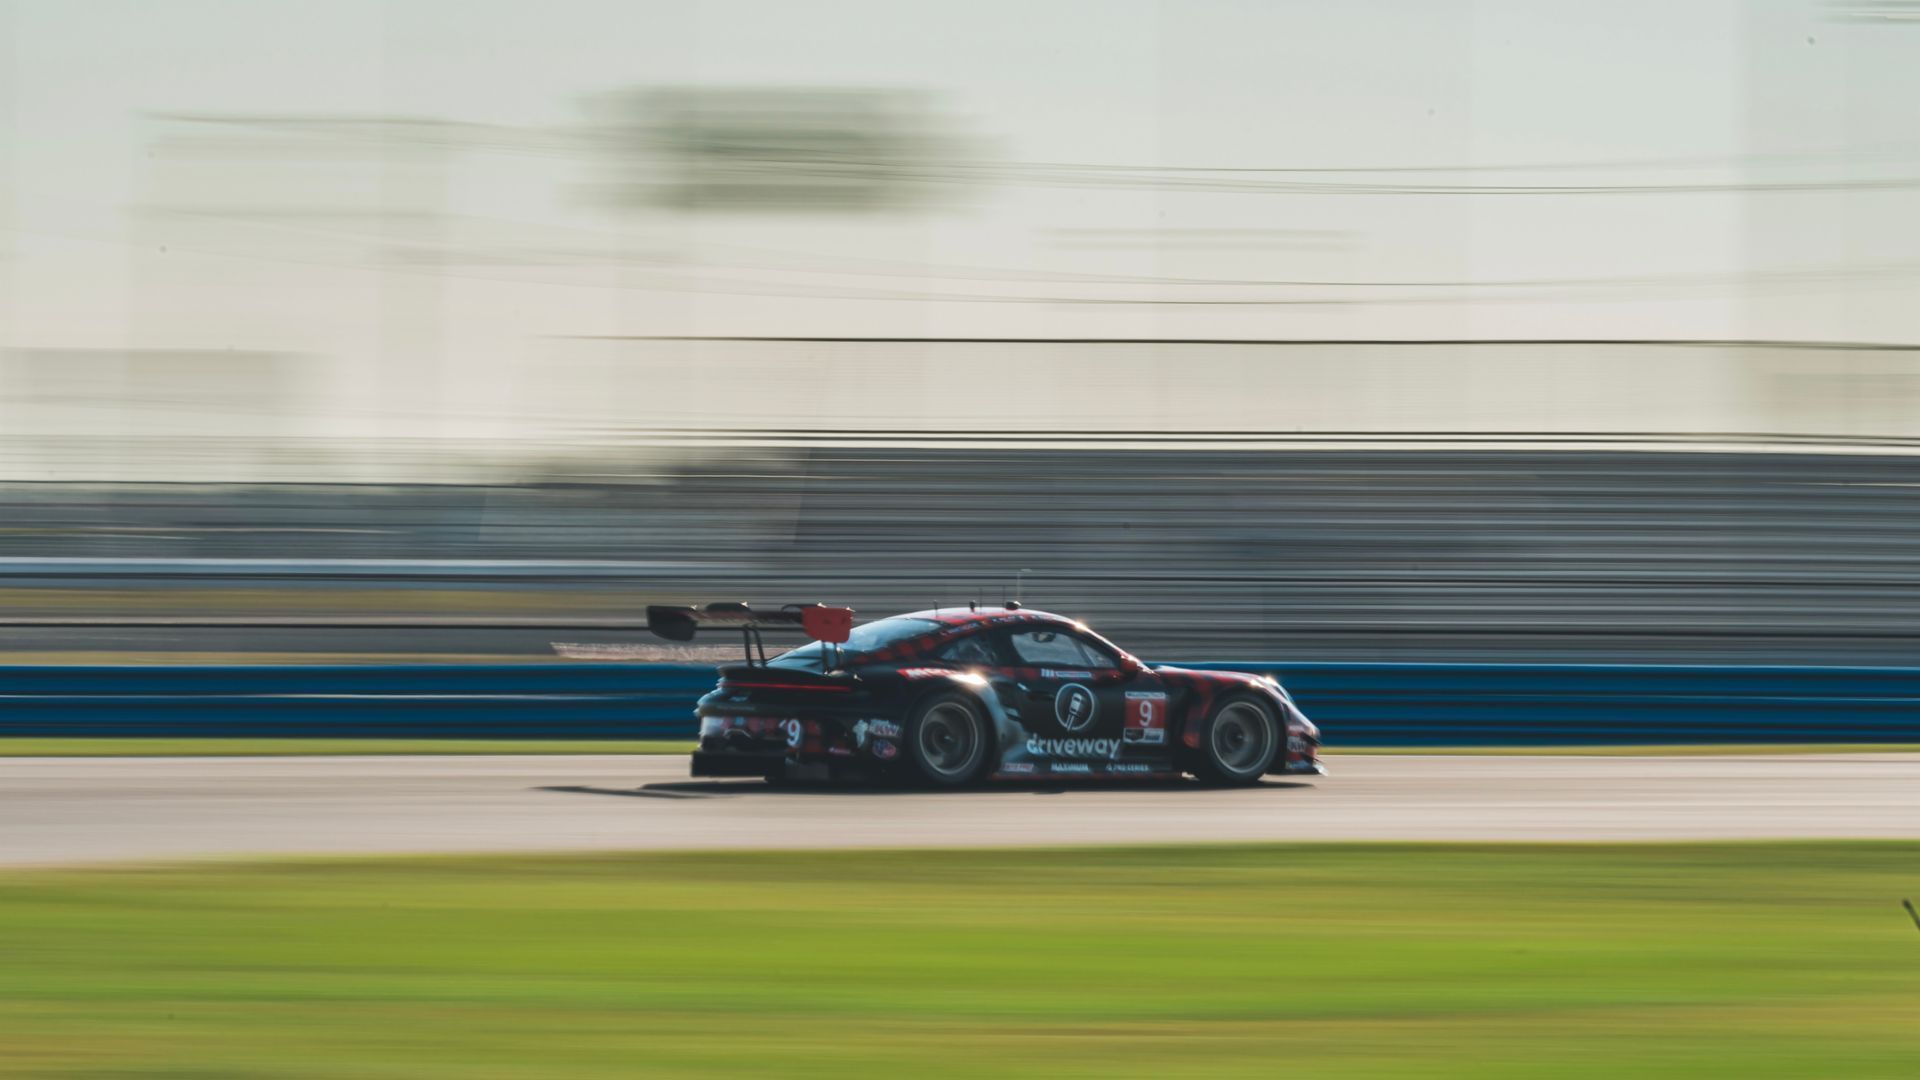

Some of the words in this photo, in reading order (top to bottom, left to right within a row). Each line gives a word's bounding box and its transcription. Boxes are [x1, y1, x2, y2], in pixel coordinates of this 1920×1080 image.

[1139, 700, 1152, 727] 9
[787, 719, 801, 747] 9
[1026, 733, 1121, 759] driveway
